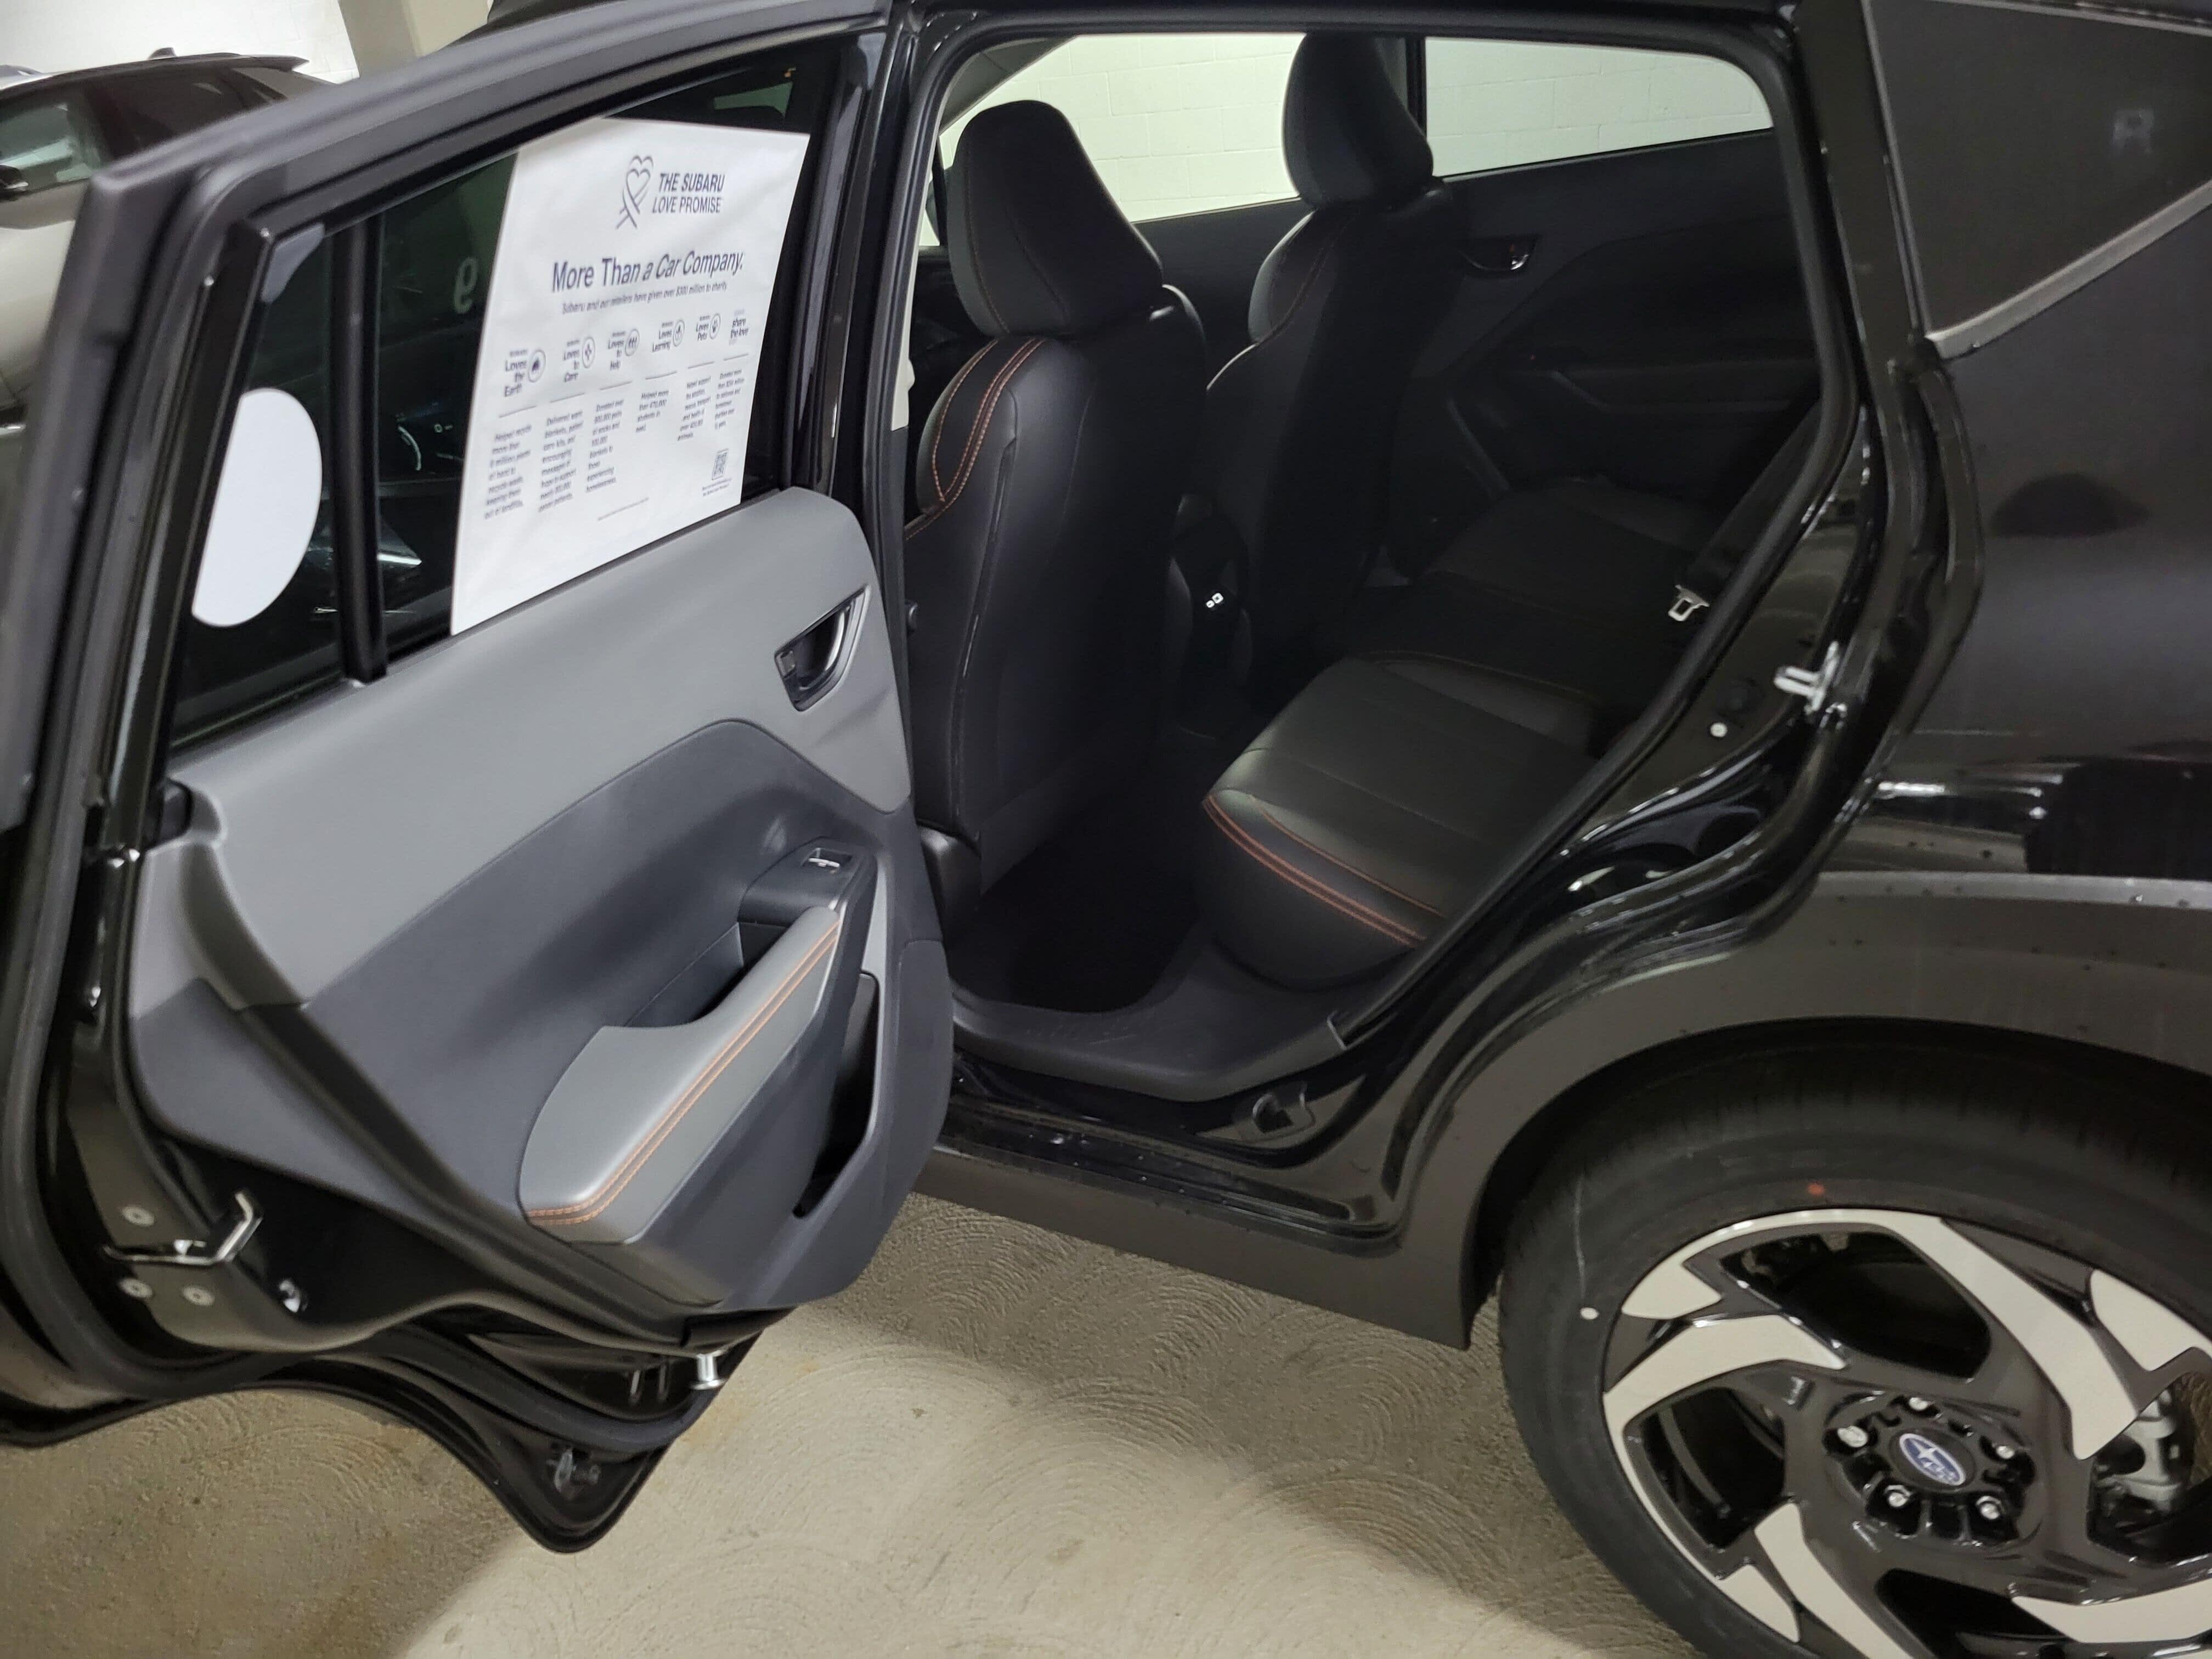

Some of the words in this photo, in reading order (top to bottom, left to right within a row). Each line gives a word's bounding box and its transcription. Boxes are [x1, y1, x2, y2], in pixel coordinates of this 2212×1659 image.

[659, 172, 680, 192] THE
[681, 172, 725, 192] SUBARU
[652, 196, 678, 213] LOVE
[679, 196, 722, 213] PROMISE
[552, 261, 594, 293] More
[602, 257, 641, 286] Than
[642, 262, 653, 281] a
[656, 253, 681, 279] Car
[683, 250, 743, 278] Company.
